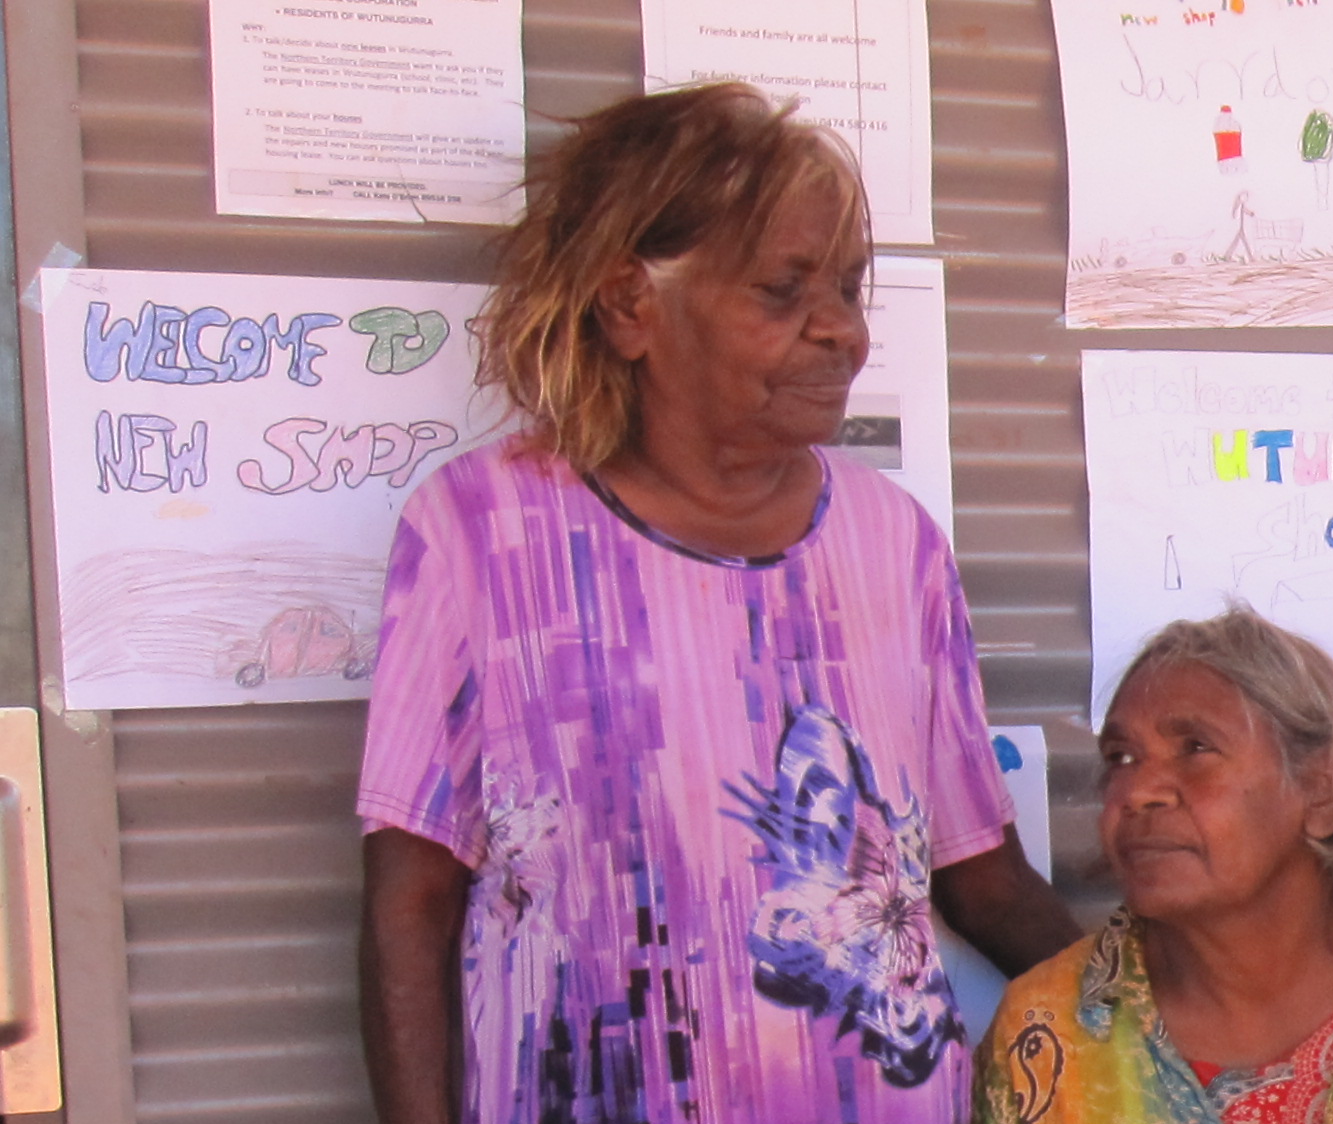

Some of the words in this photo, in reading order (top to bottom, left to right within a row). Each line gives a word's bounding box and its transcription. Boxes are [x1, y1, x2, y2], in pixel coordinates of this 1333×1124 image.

[283, 7, 339, 18] RESIDENTS
[341, 11, 353, 20] OF
[1183, 8, 1216, 26] shop
[699, 25, 737, 36] Friends
[740, 28, 760, 38] and
[762, 30, 794, 42] family
[815, 34, 827, 42] all
[830, 35, 876, 46] welcome
[751, 73, 811, 85] information
[814, 77, 846, 89] please
[85, 300, 342, 386] WELCOME
[349, 306, 450, 374] TO
[95, 410, 208, 493] NEW
